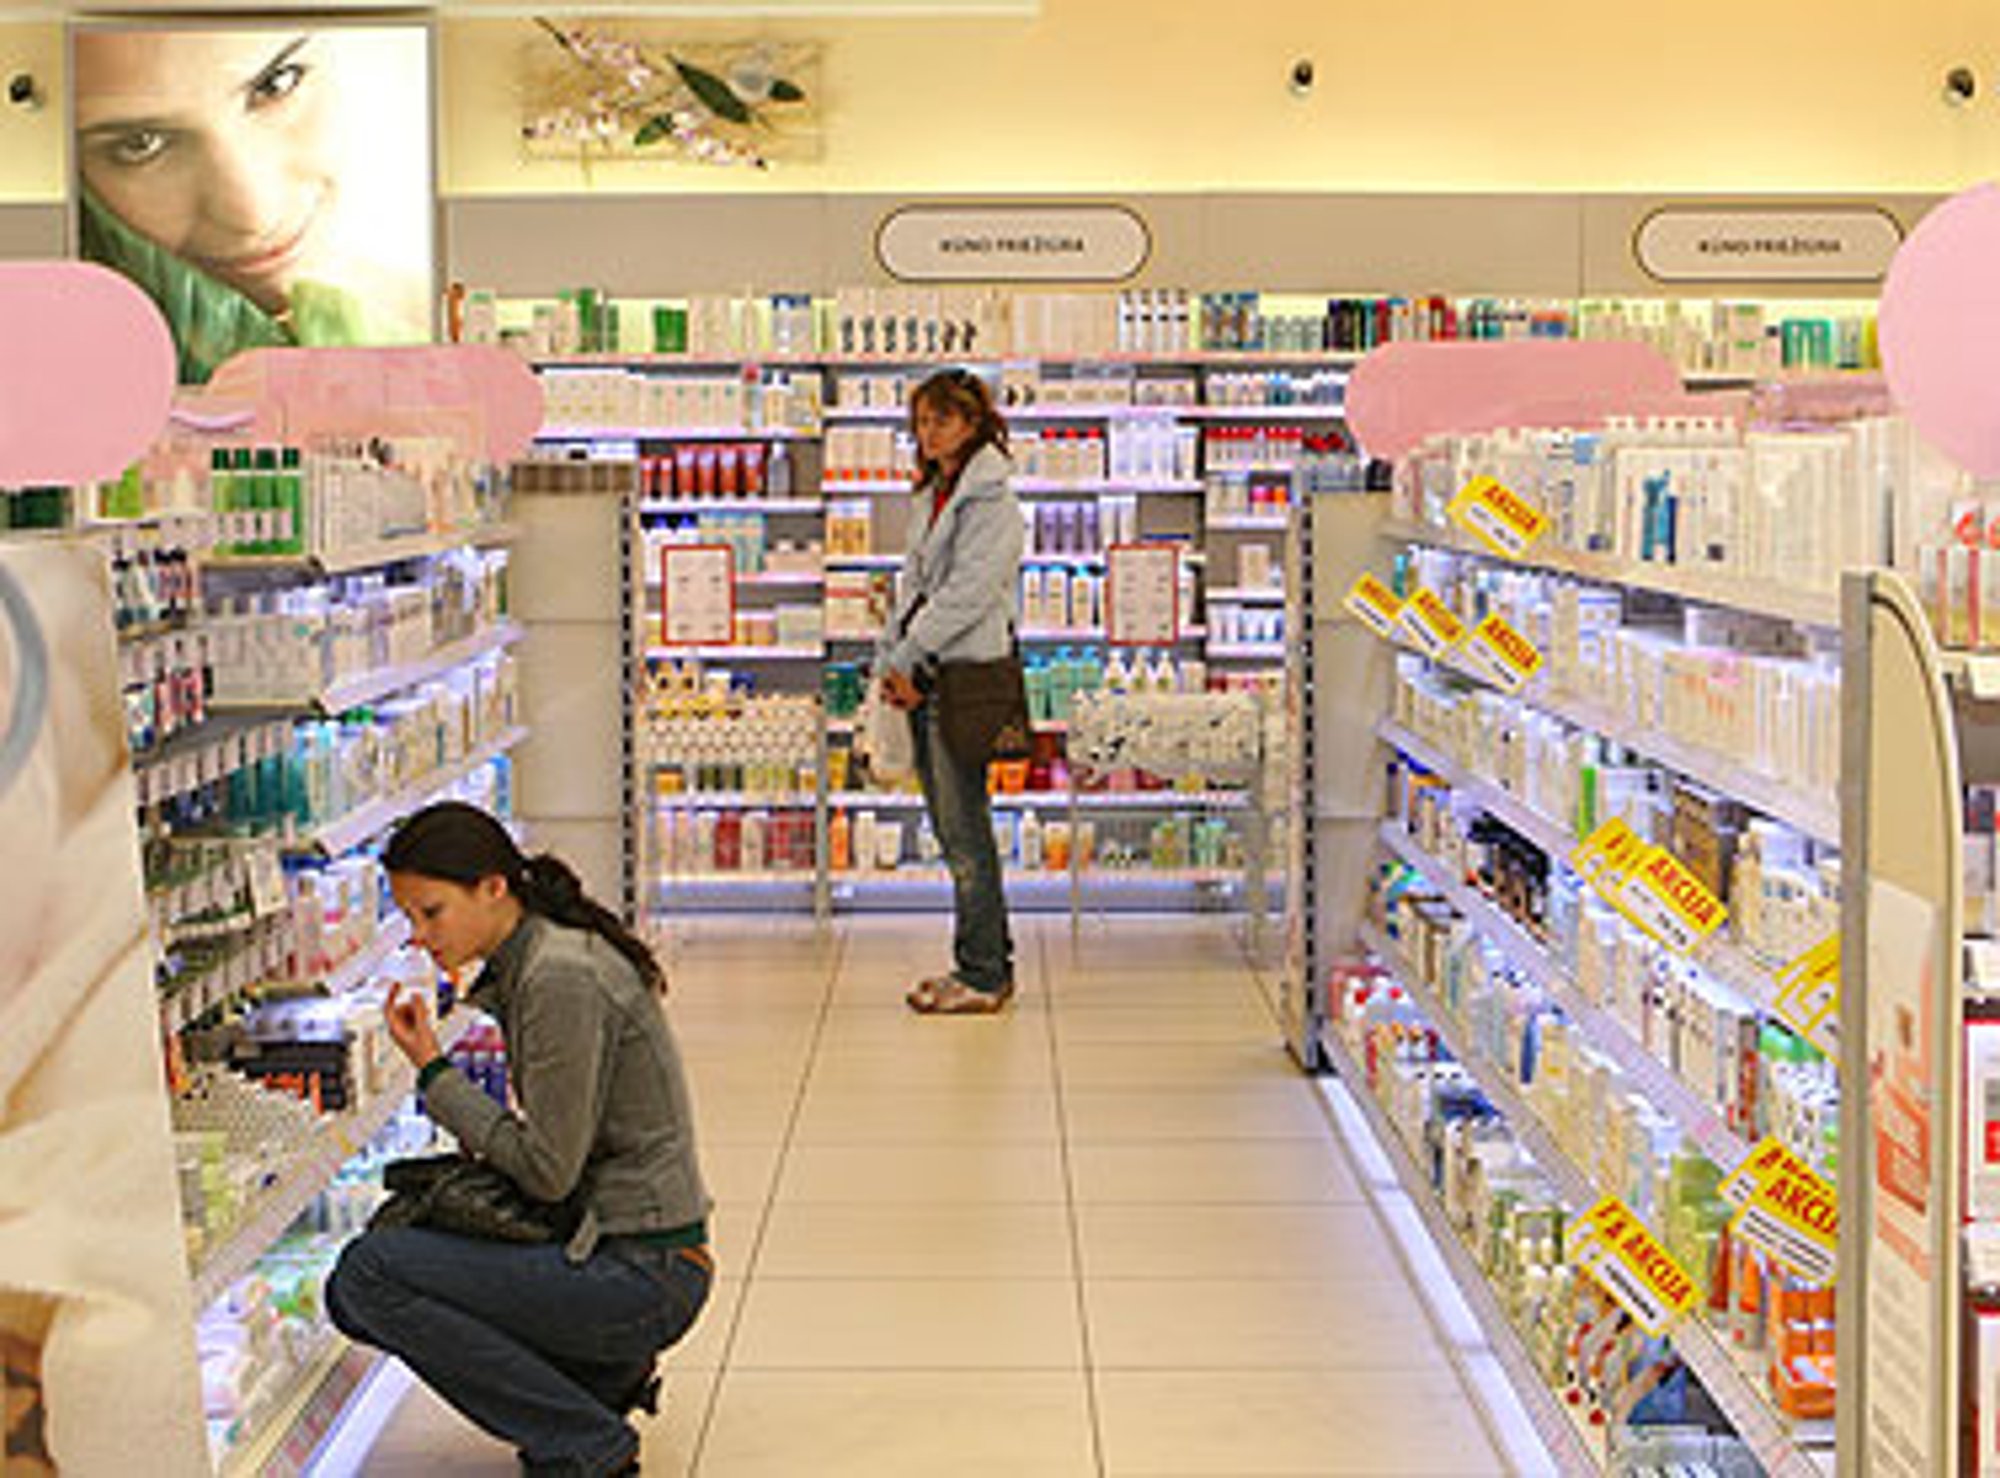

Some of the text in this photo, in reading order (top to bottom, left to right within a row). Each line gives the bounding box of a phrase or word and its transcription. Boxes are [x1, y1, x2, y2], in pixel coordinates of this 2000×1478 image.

[1484, 617, 1539, 670] AKCIJA
[1647, 857, 1719, 925] AKCIJA
[1621, 1233, 1692, 1305] AKCIJA
